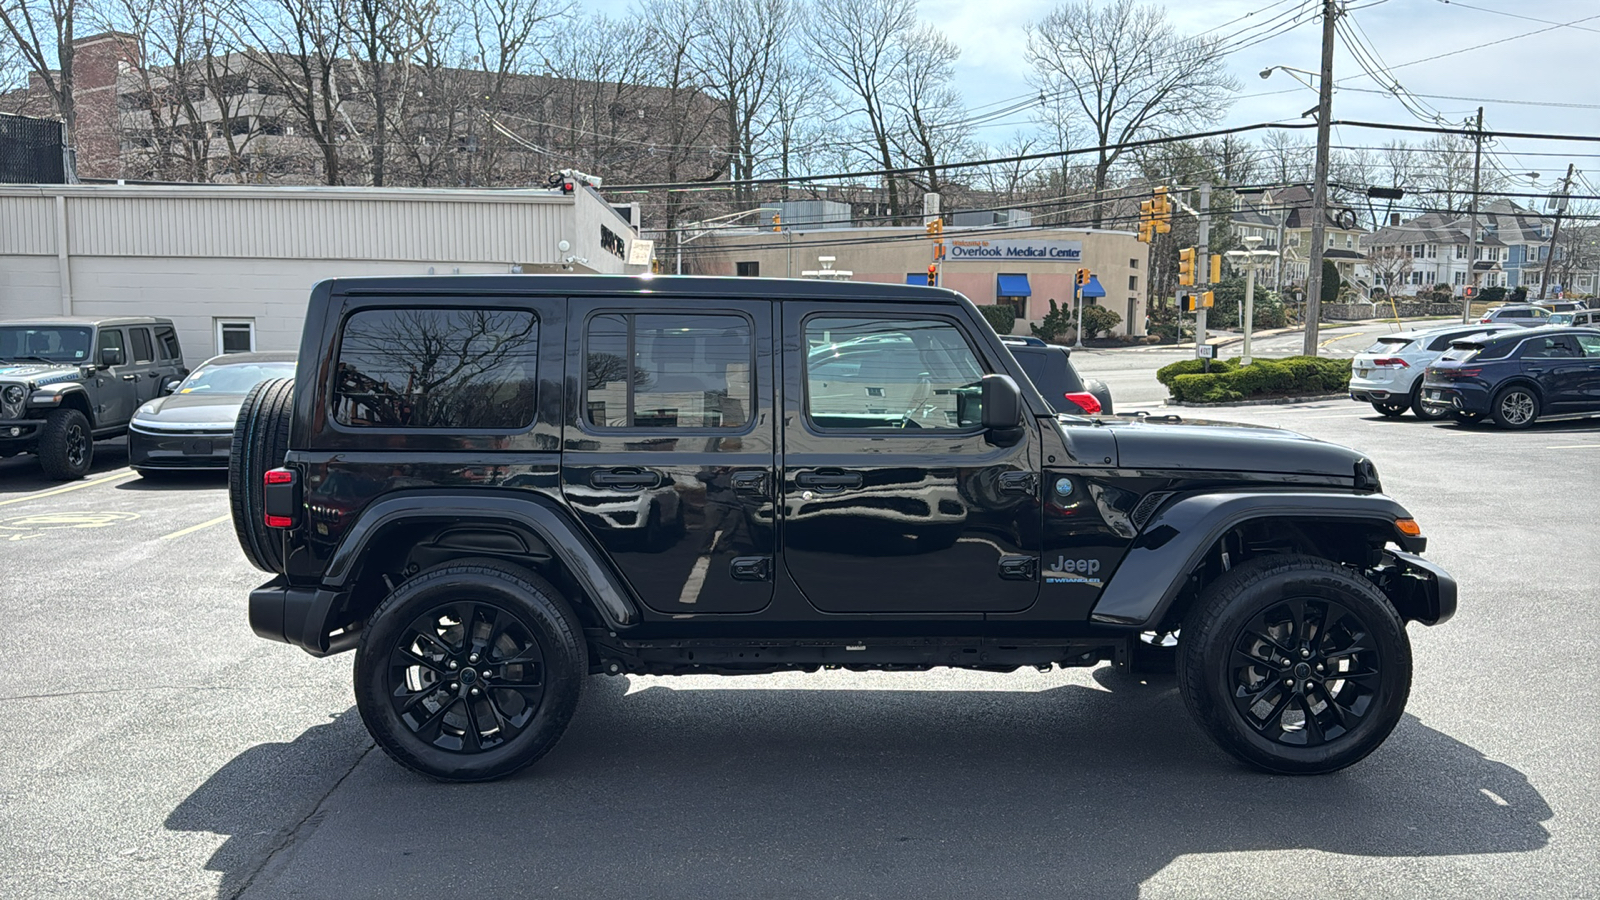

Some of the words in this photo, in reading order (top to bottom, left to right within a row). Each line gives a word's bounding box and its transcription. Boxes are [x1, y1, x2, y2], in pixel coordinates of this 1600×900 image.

[952, 246, 1002, 257] Overlook
[1006, 246, 1047, 257] Medical
[1049, 246, 1081, 257] Center
[1050, 555, 1101, 575] Jeep
